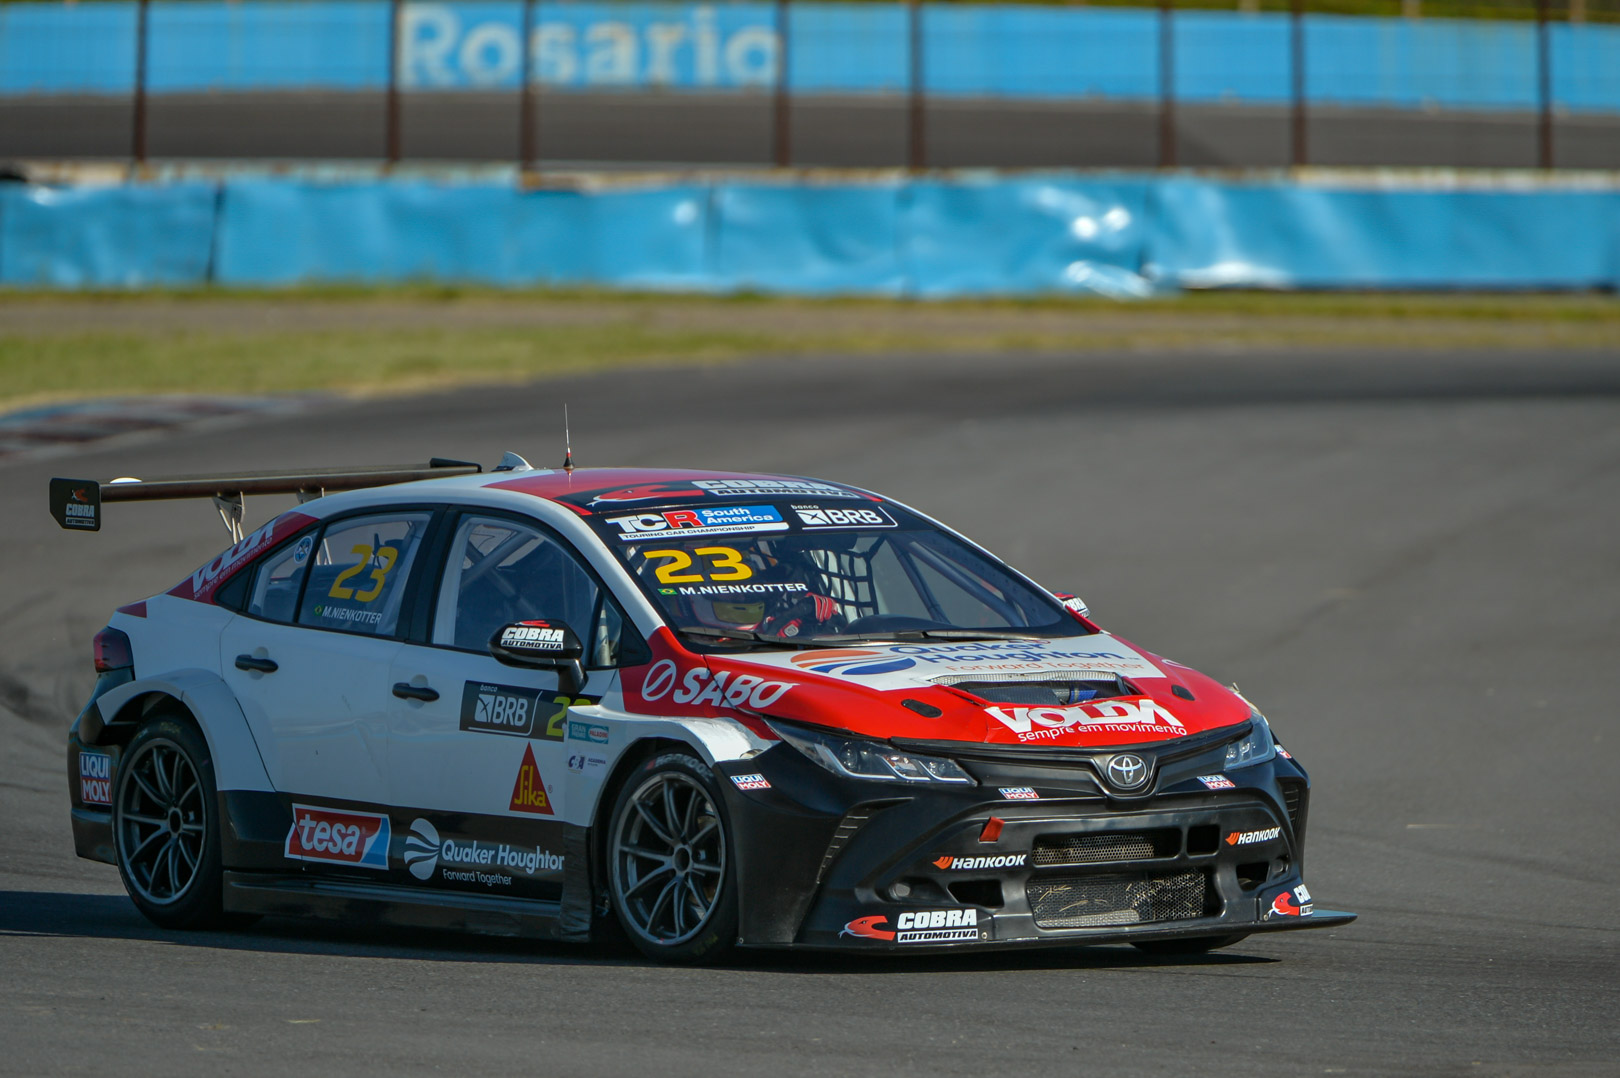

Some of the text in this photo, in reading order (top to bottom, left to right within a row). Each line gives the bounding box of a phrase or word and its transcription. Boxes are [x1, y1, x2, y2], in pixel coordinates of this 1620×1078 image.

[398, 3, 781, 86] Rosario
[691, 480, 843, 491] COBRA
[66, 503, 95, 517] COBRA
[702, 507, 750, 518] South
[825, 509, 883, 524] BRB
[605, 510, 705, 533] TCR
[706, 513, 773, 524] America
[687, 525, 755, 535] CHAMPIONSHIP
[328, 544, 398, 602] 23
[643, 546, 753, 584] 23
[679, 583, 809, 596] M.NIENKOTTER
[322, 606, 383, 625] M.NIENKOTTER
[502, 627, 565, 642] COBRA
[501, 640, 563, 650] AUTOMOTIVA
[914, 650, 1126, 664] Houghton
[945, 662, 1044, 672] Forward
[480, 684, 498, 692] banco
[673, 667, 800, 708] SABO
[493, 696, 528, 727] BRB
[984, 699, 1184, 733] VOLDA
[1018, 721, 1188, 743] sempre em movimento
[81, 755, 109, 778] LIQUI
[514, 765, 547, 807] Sika
[734, 774, 763, 783] LIQUI
[738, 780, 767, 789] MOLY
[82, 780, 110, 802] MOLY
[1001, 786, 1033, 794] LIQUI
[299, 813, 361, 856] tesa
[442, 840, 496, 864] Quaker
[443, 868, 512, 886] Forward Together
[897, 908, 977, 930] COBRA
[899, 929, 978, 941] AUTOMOTIVA
